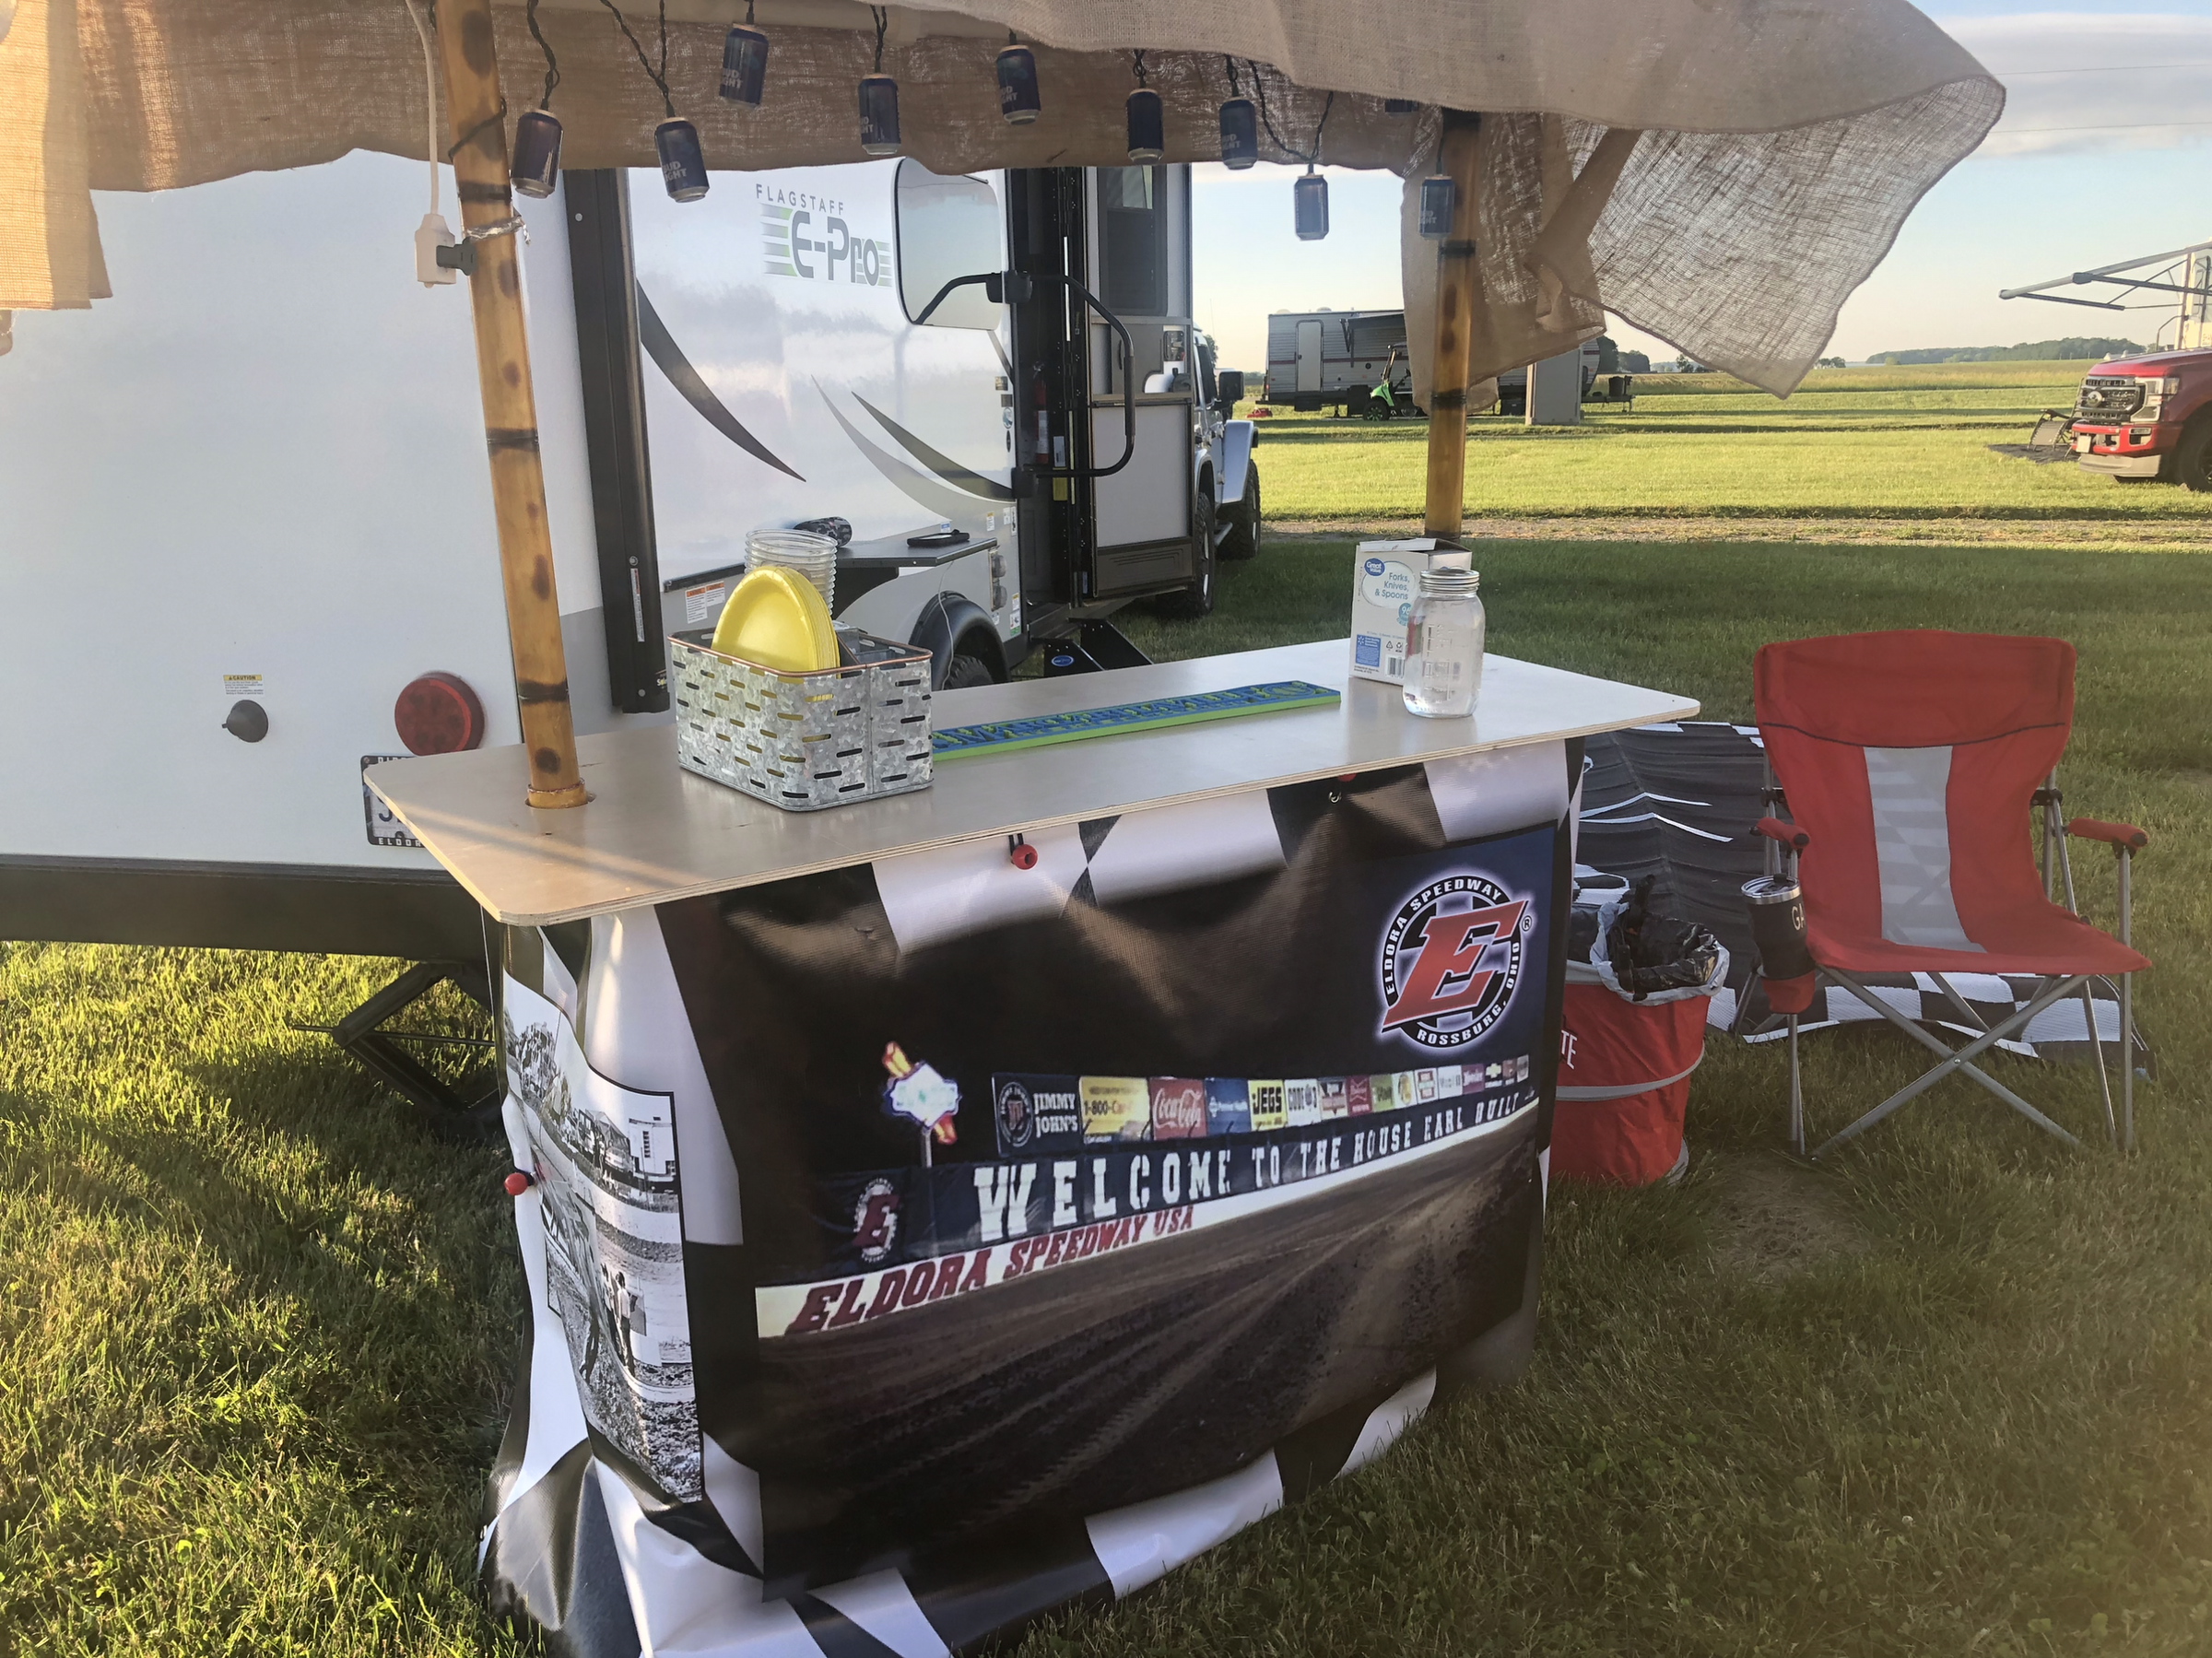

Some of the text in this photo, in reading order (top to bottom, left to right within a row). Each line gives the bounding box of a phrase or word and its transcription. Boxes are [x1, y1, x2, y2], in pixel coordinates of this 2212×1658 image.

[756, 183, 844, 216] FLAGSTAFF
[1384, 581, 1409, 593] Knives,
[1389, 572, 1410, 583] Forks,
[1374, 588, 1408, 600] & Spoons
[1384, 878, 1502, 995] ELDORA SPEEDWAY
[1382, 900, 1529, 1033] E
[1505, 942, 1520, 990] OHIO
[1033, 1093, 1076, 1115] JIMMY
[1252, 1087, 1282, 1115] JEGS
[1035, 1114, 1078, 1138] JOHN'S
[973, 1092, 1520, 1242] WELCOME TO THE HOUSE EARL BUILT
[784, 1205, 1194, 1335] ELDORA SPEEDWAY USA
